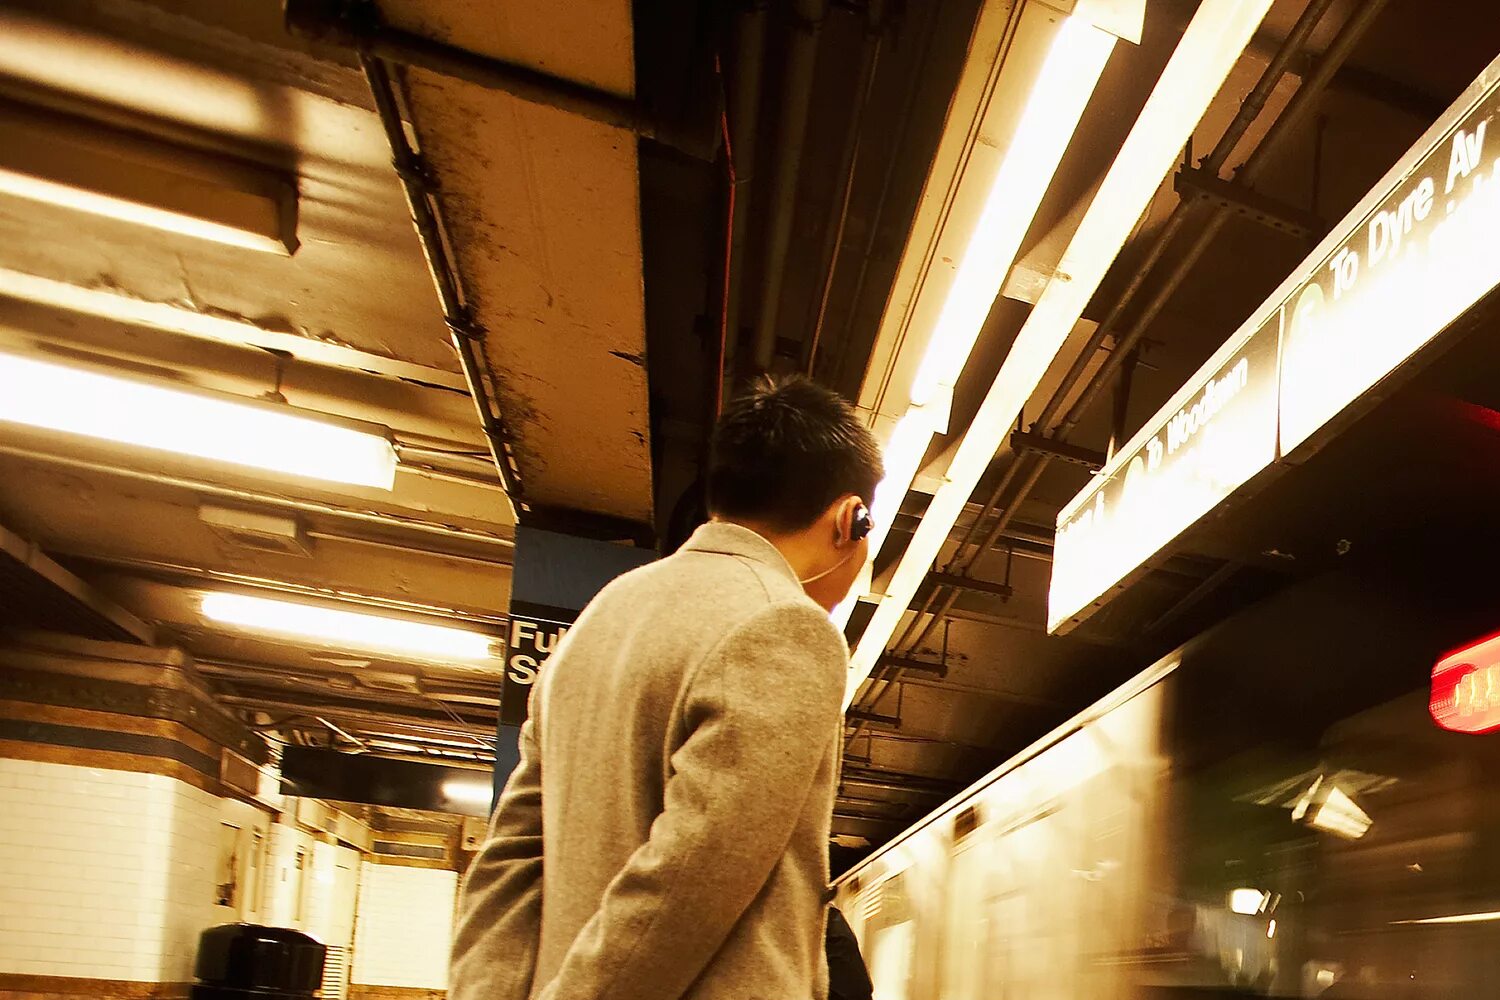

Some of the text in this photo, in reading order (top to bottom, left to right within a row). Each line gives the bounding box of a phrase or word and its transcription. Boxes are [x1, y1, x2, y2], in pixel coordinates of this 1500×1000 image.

[1330, 247, 1360, 300] To
[1368, 176, 1435, 268] Dyre
[1444, 120, 1488, 194] Av
[508, 654, 546, 685] S
